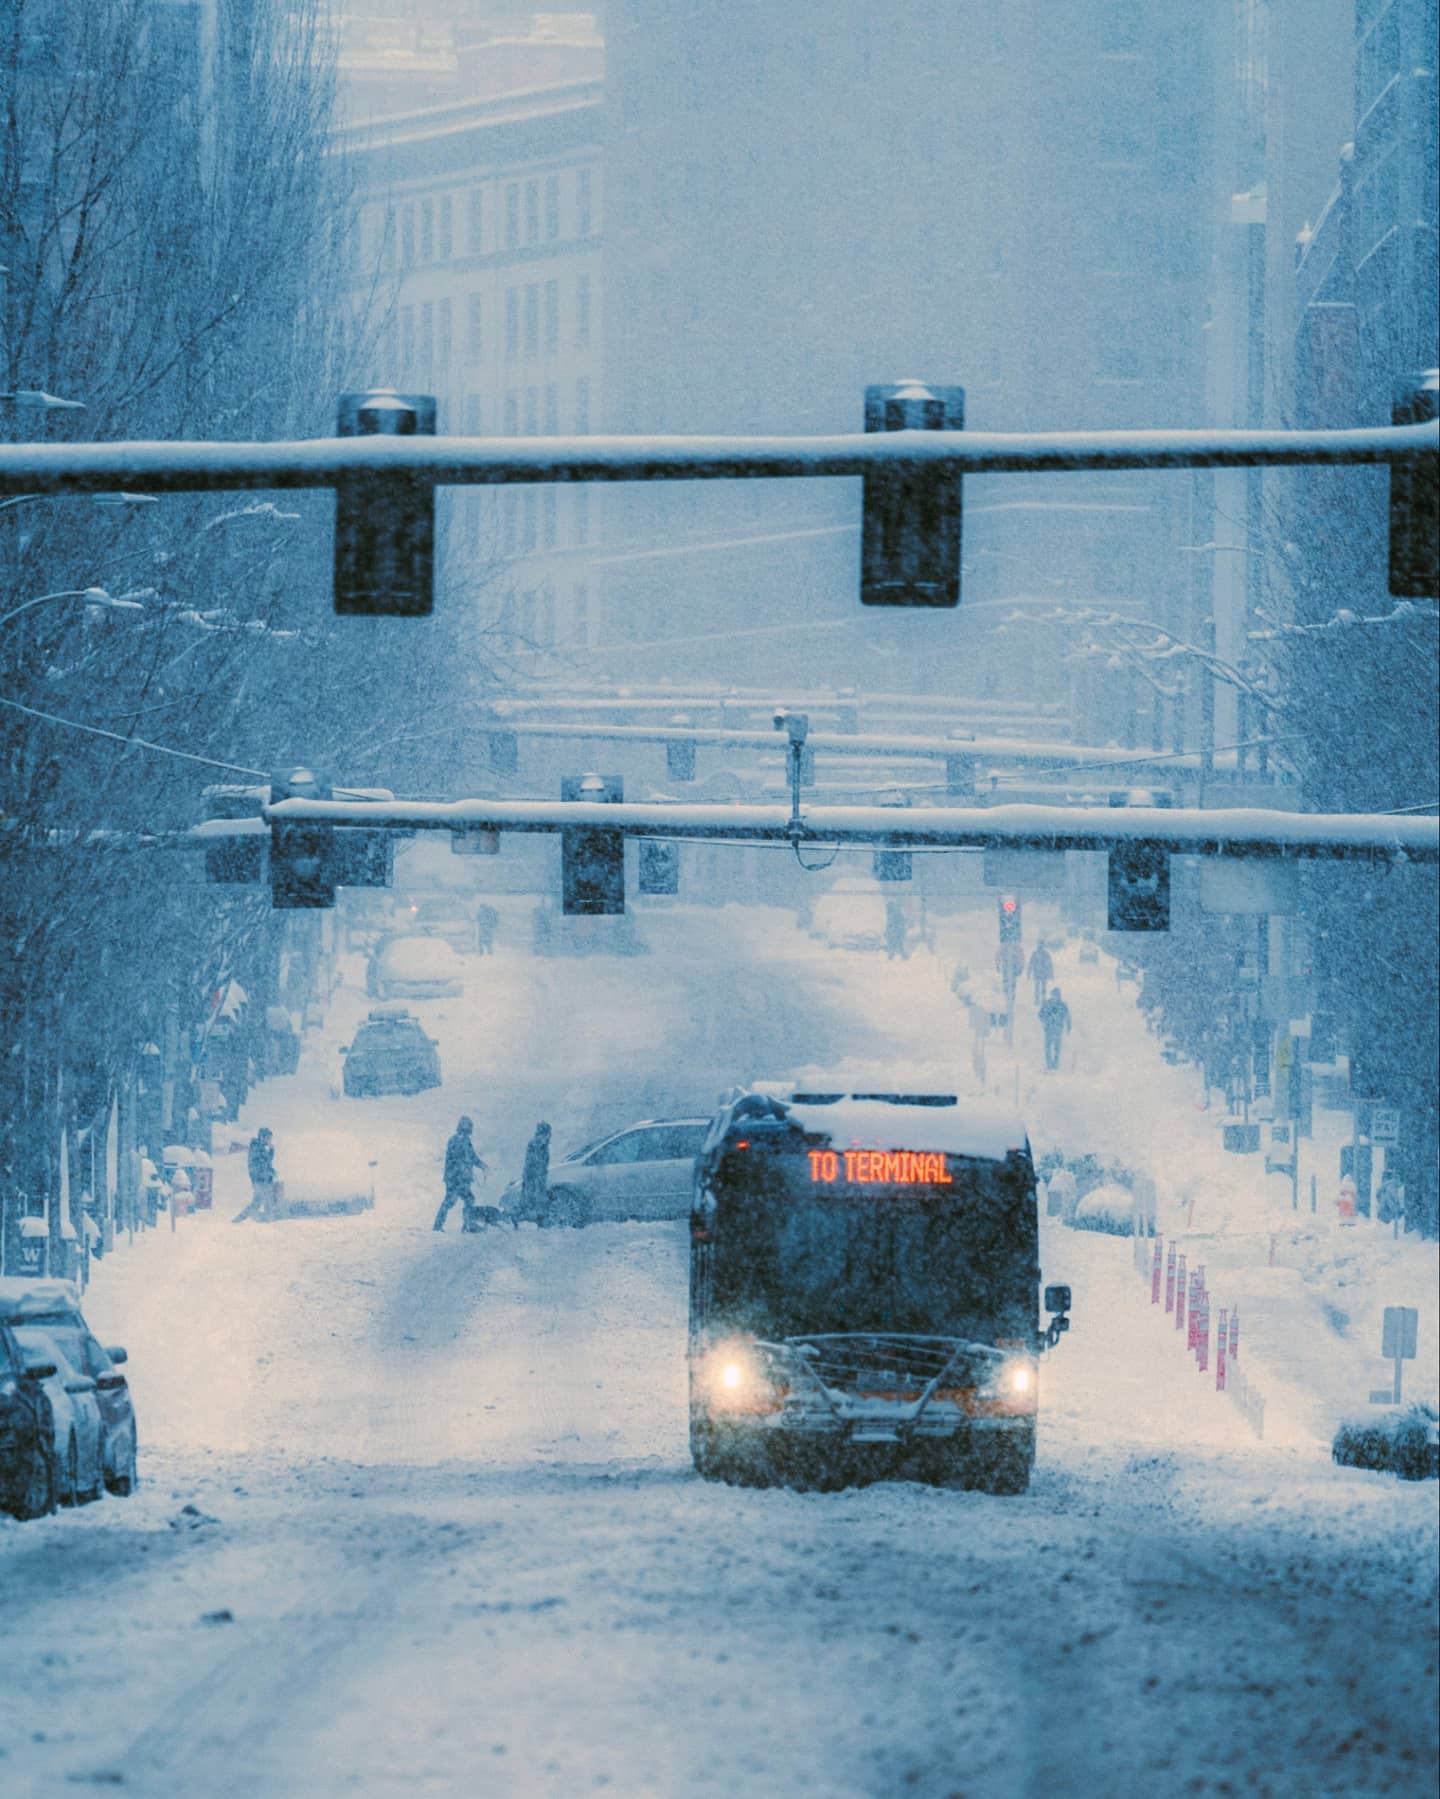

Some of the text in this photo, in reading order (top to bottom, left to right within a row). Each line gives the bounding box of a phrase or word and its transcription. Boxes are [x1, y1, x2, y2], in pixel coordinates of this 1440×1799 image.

[808, 1150, 952, 1183] TO TERMINAL
[22, 1247, 41, 1262] W
